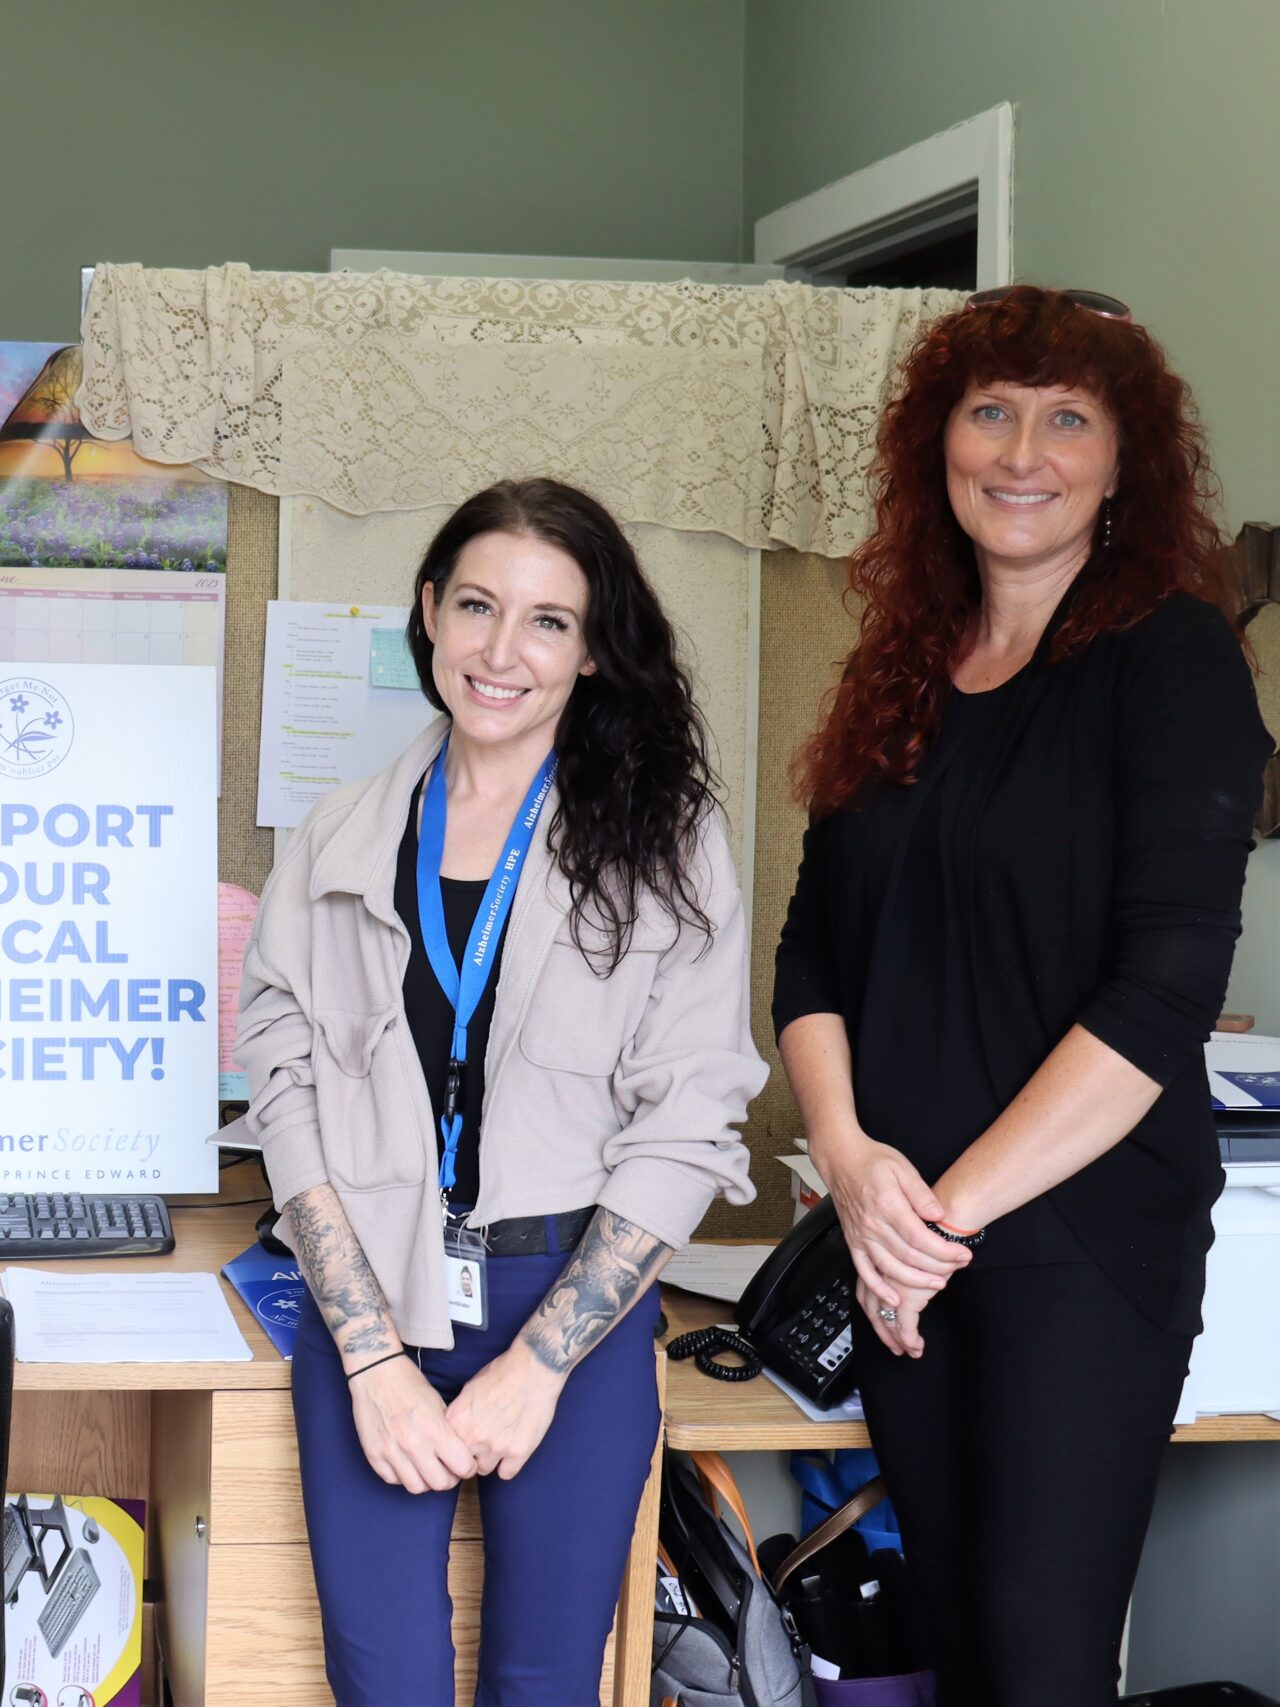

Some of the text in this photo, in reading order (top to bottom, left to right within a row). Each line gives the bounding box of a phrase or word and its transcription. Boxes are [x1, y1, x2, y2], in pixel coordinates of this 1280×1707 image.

[23, 680, 39, 690] Me
[41, 687, 58, 703] Not
[504, 848, 521, 871] HPE
[85, 1169, 161, 1179] EDWARD
